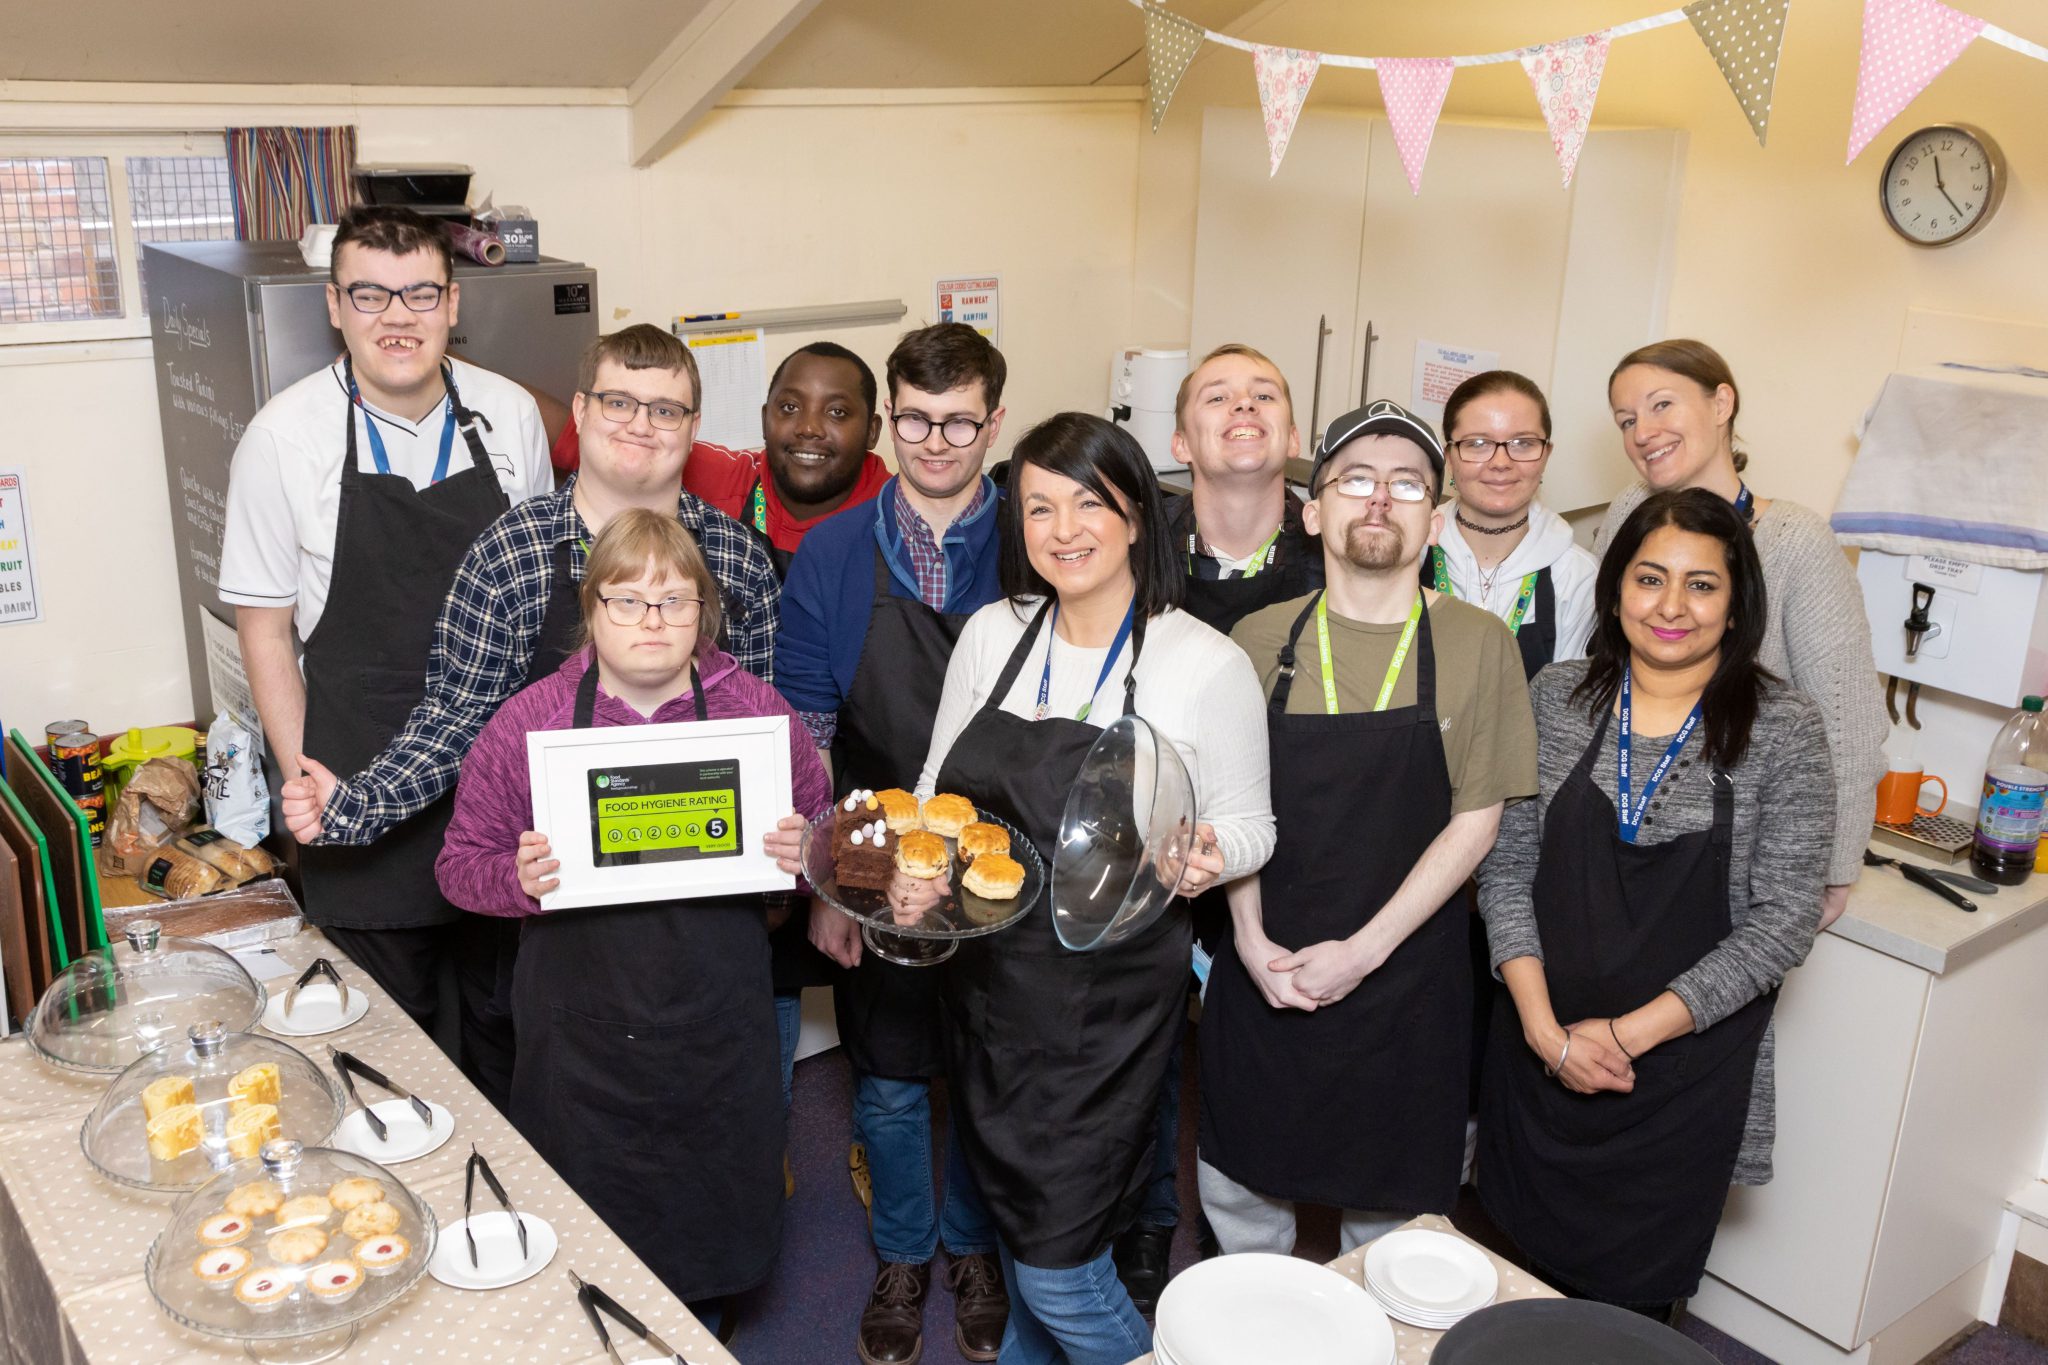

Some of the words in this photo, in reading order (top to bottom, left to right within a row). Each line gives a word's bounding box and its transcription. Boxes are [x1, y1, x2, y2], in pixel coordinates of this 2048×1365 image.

[1921, 144, 1935, 157] 11
[1941, 140, 1954, 152] 12
[1960, 147, 1968, 158] 1
[1905, 156, 1919, 171] 10
[1970, 163, 1981, 172] 2
[1900, 178, 1909, 186] 9
[1972, 183, 1982, 192] 3
[1902, 197, 1911, 207] 8
[1965, 201, 1973, 210] 4
[1912, 213, 1921, 222] 7
[1930, 218, 1938, 229] 6
[1949, 214, 1957, 225] 5
[504, 234, 518, 244] 30
[566, 285, 578, 298] 10
[961, 297, 973, 305] RAW
[974, 296, 988, 304] MEAT
[963, 313, 975, 321] RAW
[975, 312, 988, 320] FISH
[162, 296, 182, 351] Daily
[166, 361, 193, 392] Toasted
[195, 371, 215, 402] Panini
[1924, 555, 1947, 565] PLEASE
[1948, 559, 1969, 569] EMPTY
[1929, 563, 1945, 571] DRIP
[1947, 566, 1963, 575] TRAY
[4, 601, 32, 614] DAIRY
[1392, 650, 1405, 668] DCG
[1400, 619, 1416, 648] Student
[1621, 722, 1629, 735] Staff
[1676, 729, 1688, 743] DCG
[1685, 716, 1697, 731] Staff
[1652, 769, 1663, 782] DCG
[1660, 755, 1672, 769] Staff
[1996, 781, 2018, 791] DOUBLE
[605, 801, 638, 812] FOOD
[641, 798, 686, 810] HYGIENE
[689, 795, 727, 806] RATING
[1621, 808, 1629, 824] Staff
[1631, 812, 1641, 826] DCG
[1638, 796, 1647, 811] Staff
[710, 820, 723, 837] 5
